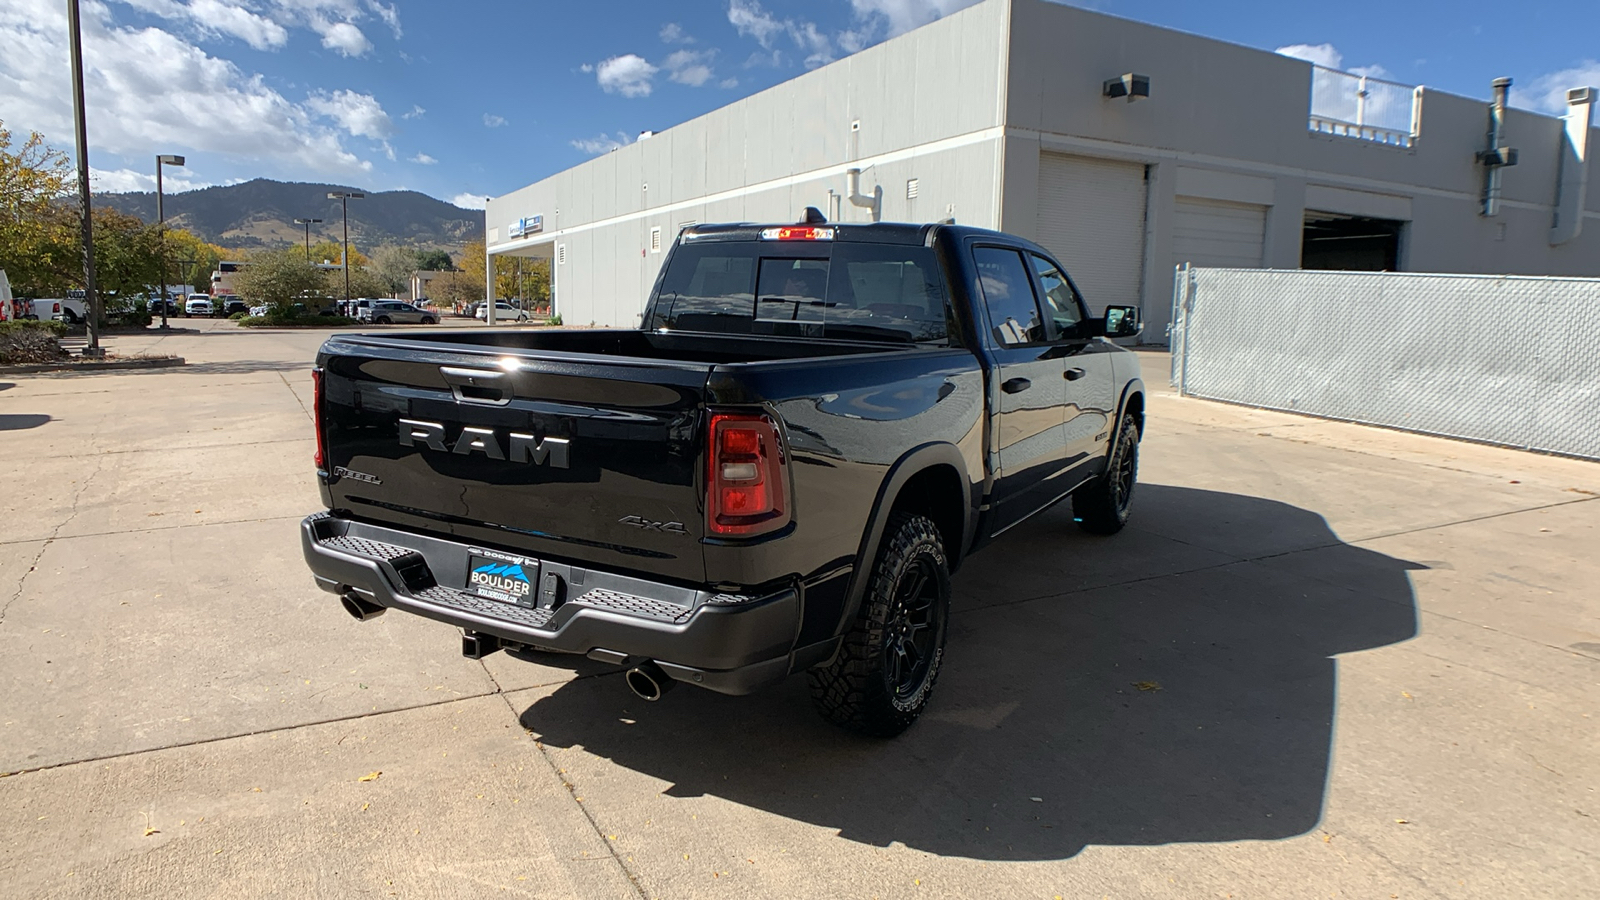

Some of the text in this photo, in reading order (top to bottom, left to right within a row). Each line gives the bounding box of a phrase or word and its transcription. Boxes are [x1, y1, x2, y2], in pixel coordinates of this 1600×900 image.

[399, 418, 570, 469] RAM
[334, 465, 383, 485] REBEL
[471, 571, 530, 596] BOULDER
